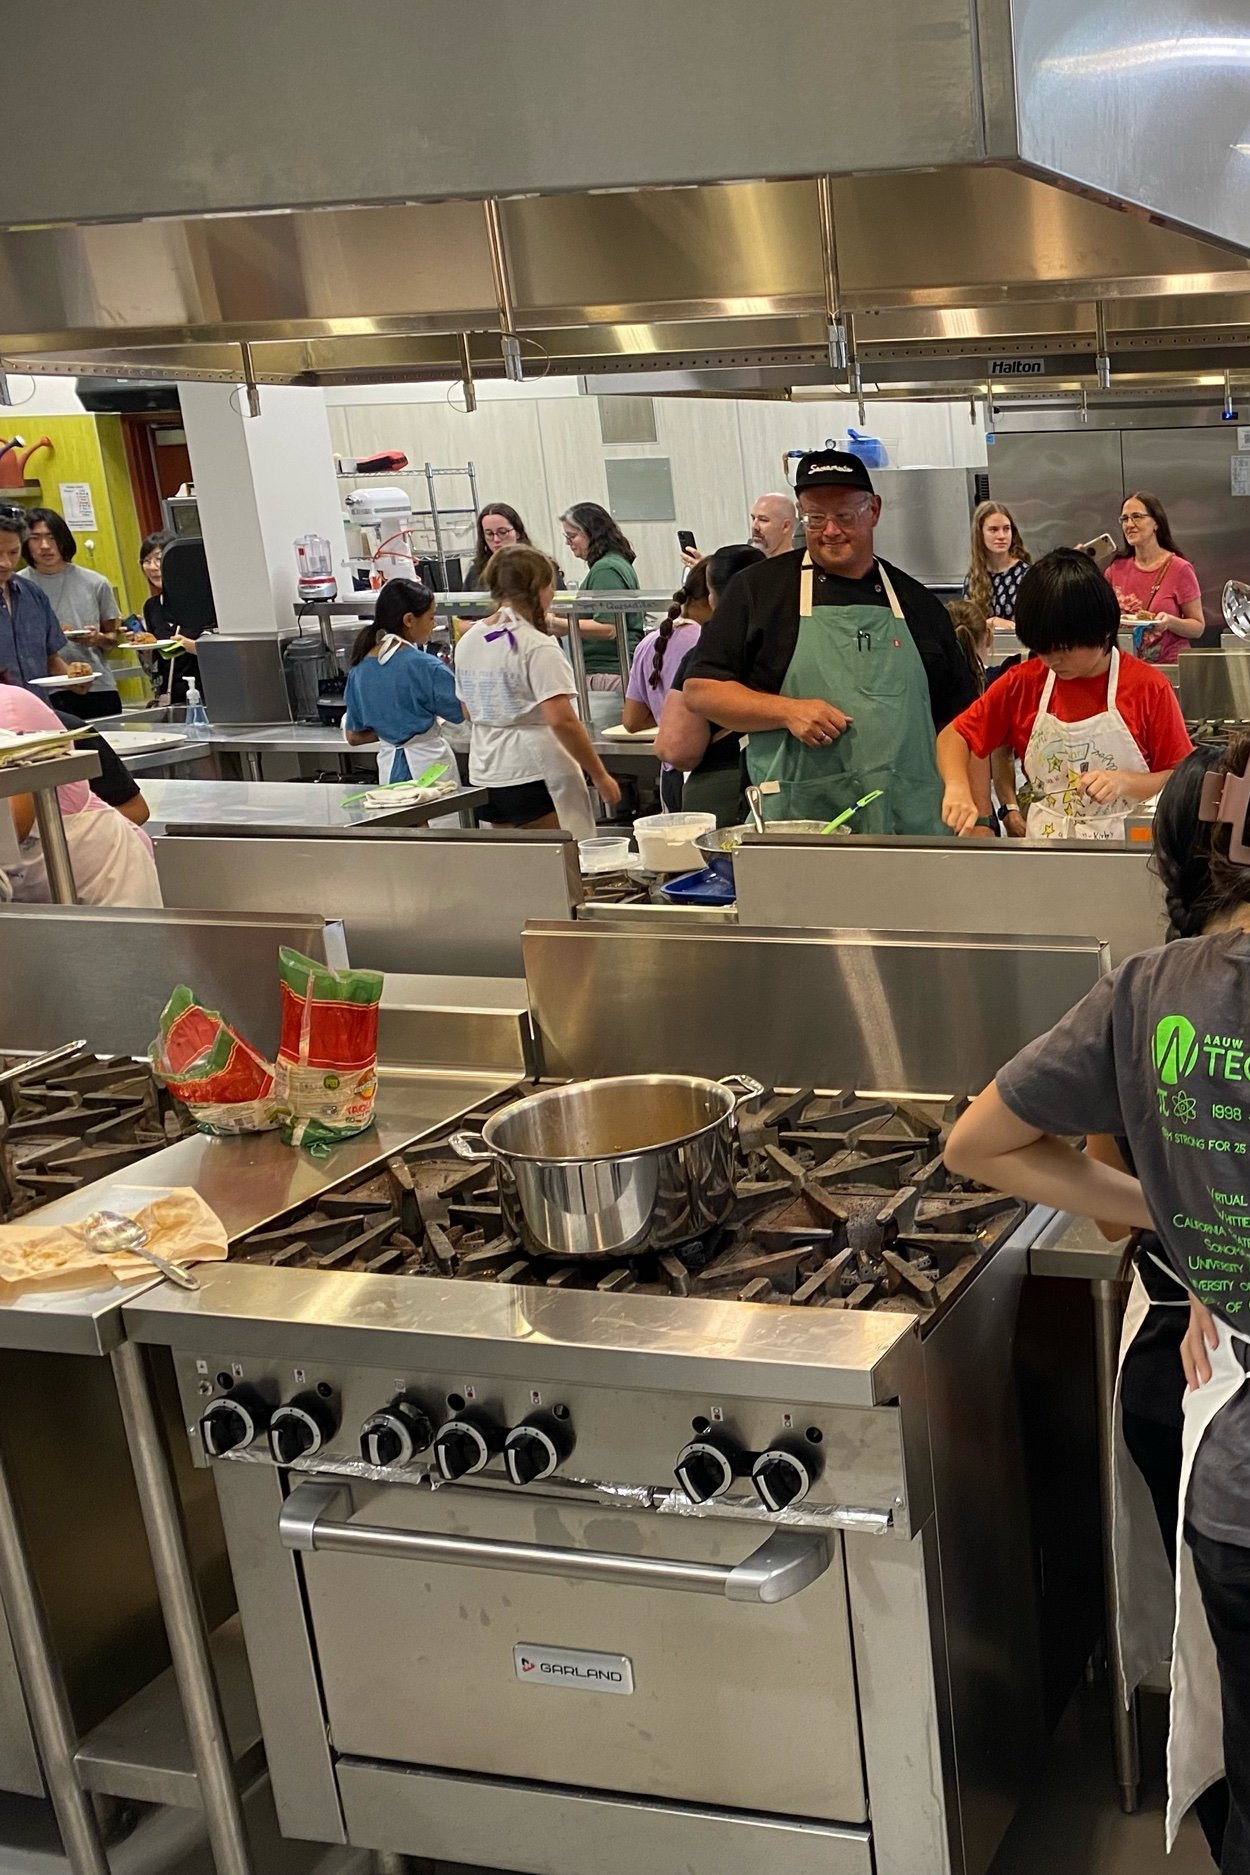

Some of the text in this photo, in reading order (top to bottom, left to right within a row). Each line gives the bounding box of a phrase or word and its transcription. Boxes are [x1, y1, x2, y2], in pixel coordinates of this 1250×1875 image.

[991, 360, 1042, 374] Halton
[1204, 1034, 1243, 1050] AAUW
[1212, 1103, 1242, 1121] 1998
[1174, 1132, 1205, 1150] STRONG
[1208, 1140, 1231, 1152] FOR
[1234, 1143, 1246, 1154] 25
[1225, 1301, 1243, 1314] OF
[540, 1662, 623, 1682] GARLAND
